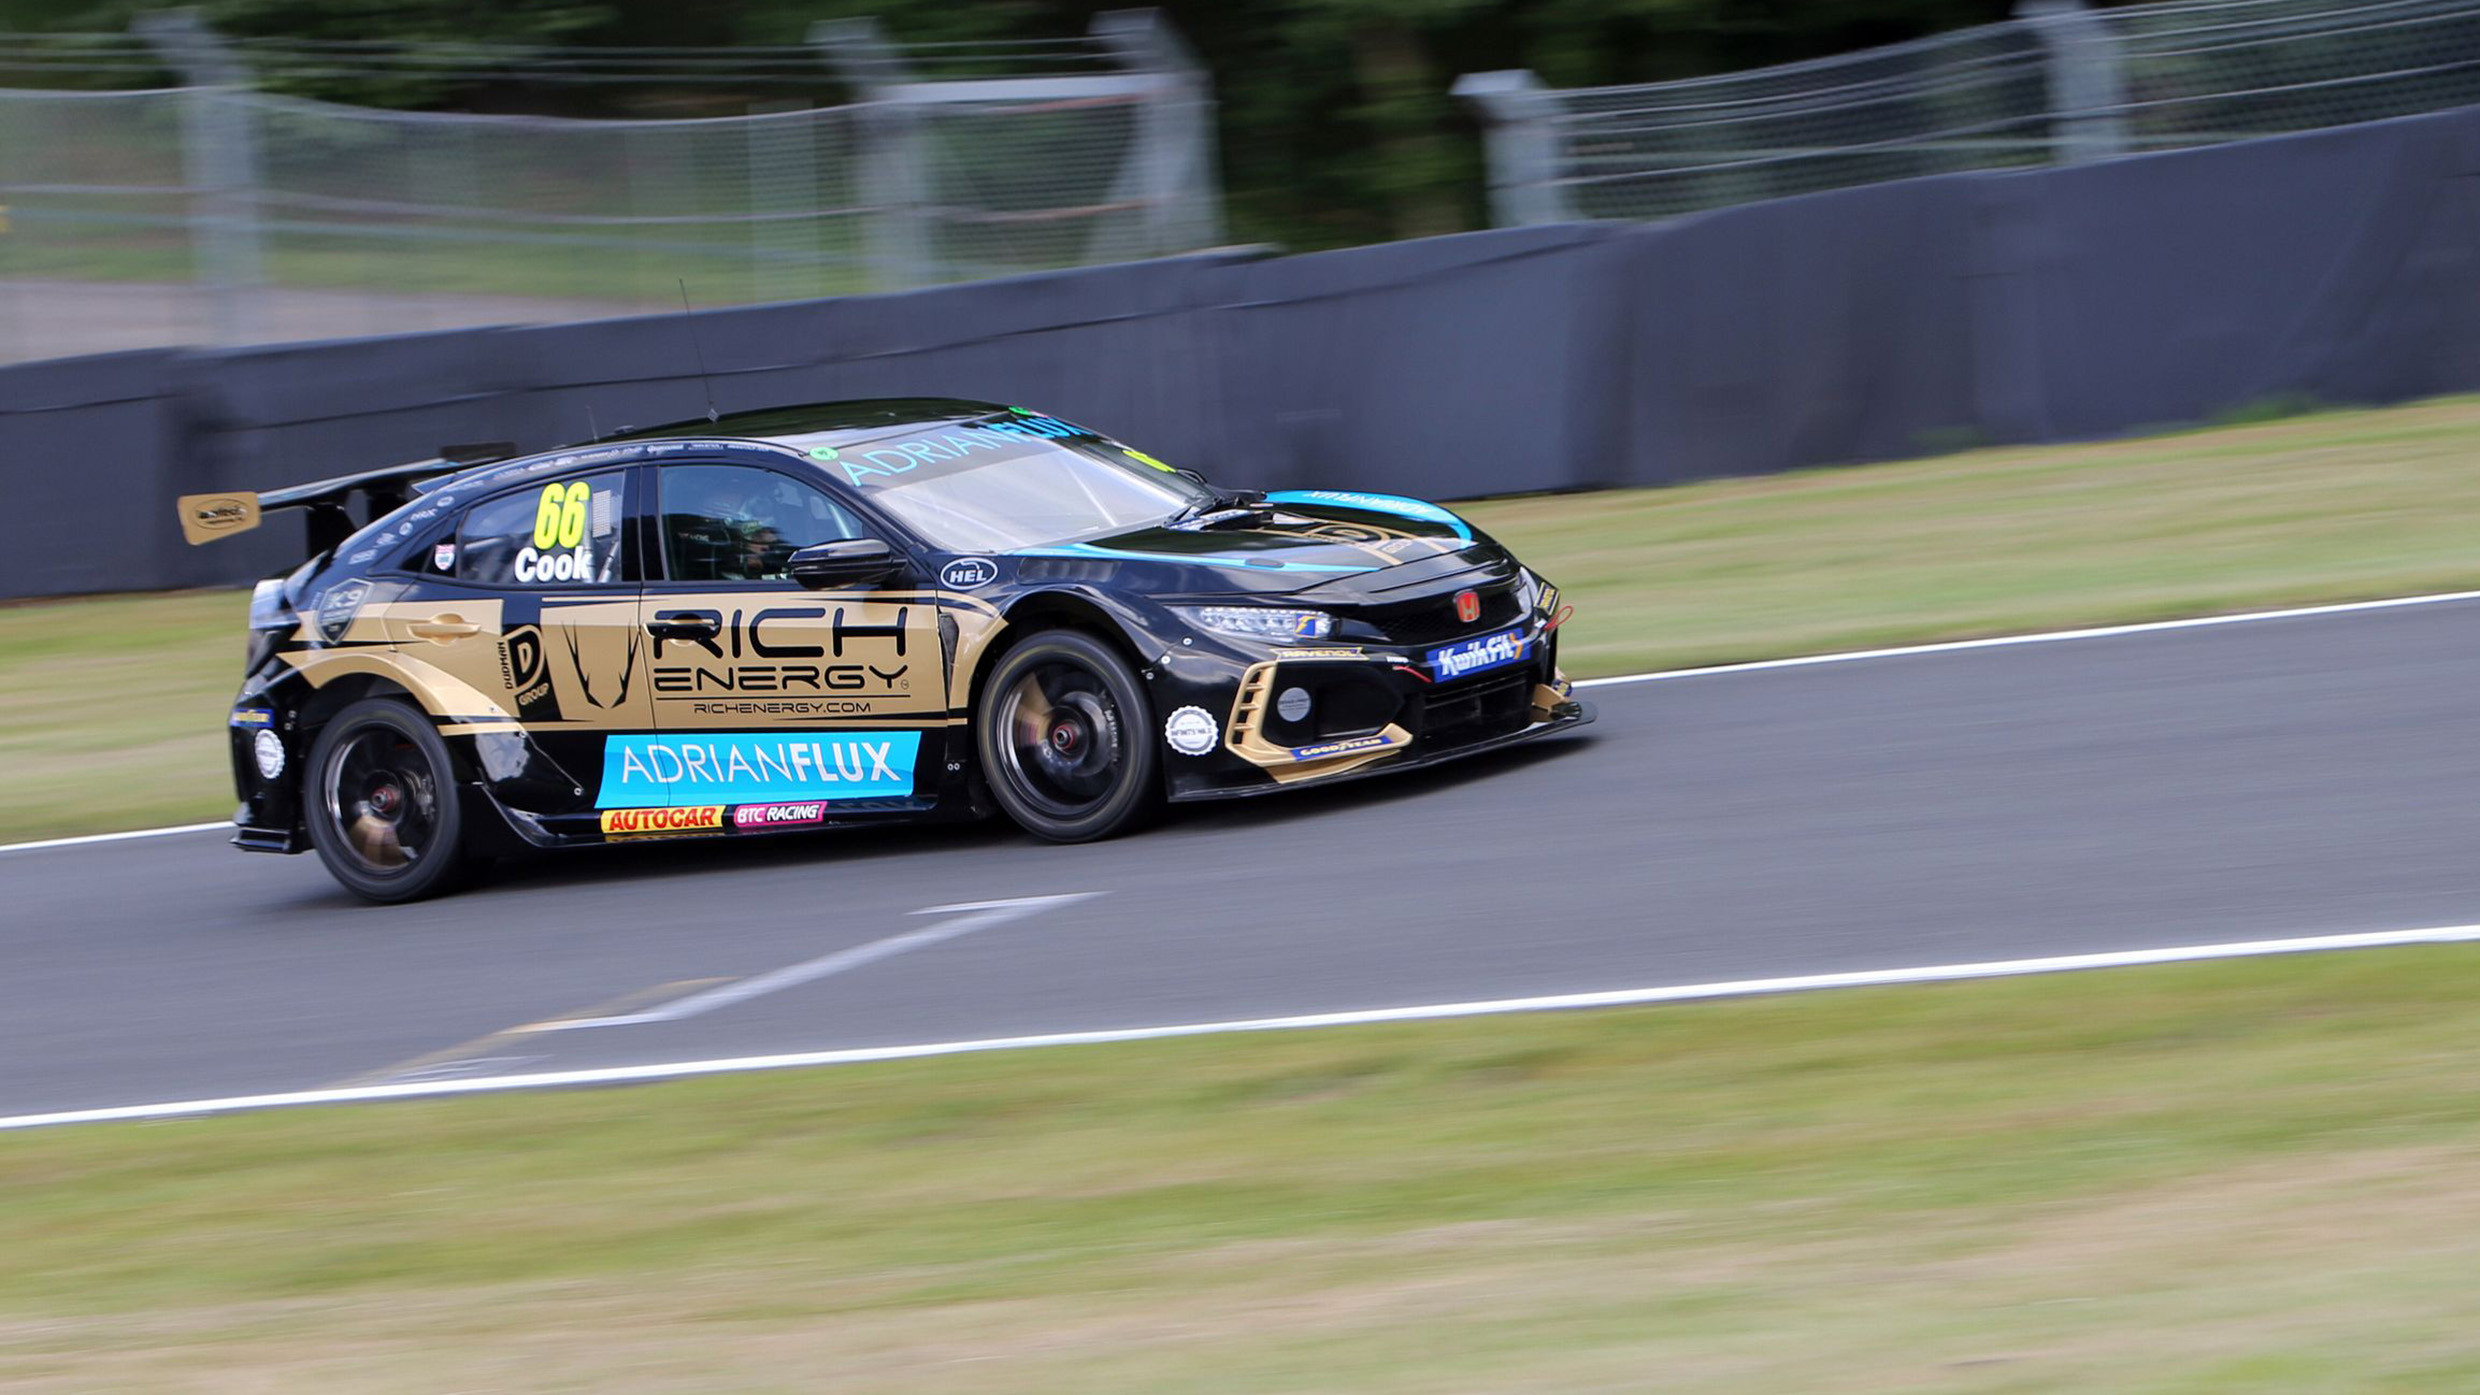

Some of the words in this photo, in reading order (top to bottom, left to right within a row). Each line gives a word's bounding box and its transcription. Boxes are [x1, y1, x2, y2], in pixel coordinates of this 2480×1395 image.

[839, 417, 1094, 487] ADRIANFLUX
[533, 481, 591, 550] 66
[514, 545, 593, 583] Cook
[949, 569, 988, 583] HEL
[653, 606, 909, 660] RICH
[653, 664, 909, 692] ENERGY
[693, 702, 872, 714] RICHENERGY.COM
[621, 742, 902, 783] ADRIANFLUX
[609, 807, 716, 831] AUTOCAR
[736, 806, 766, 824] BTC
[766, 803, 820, 822] RACING
